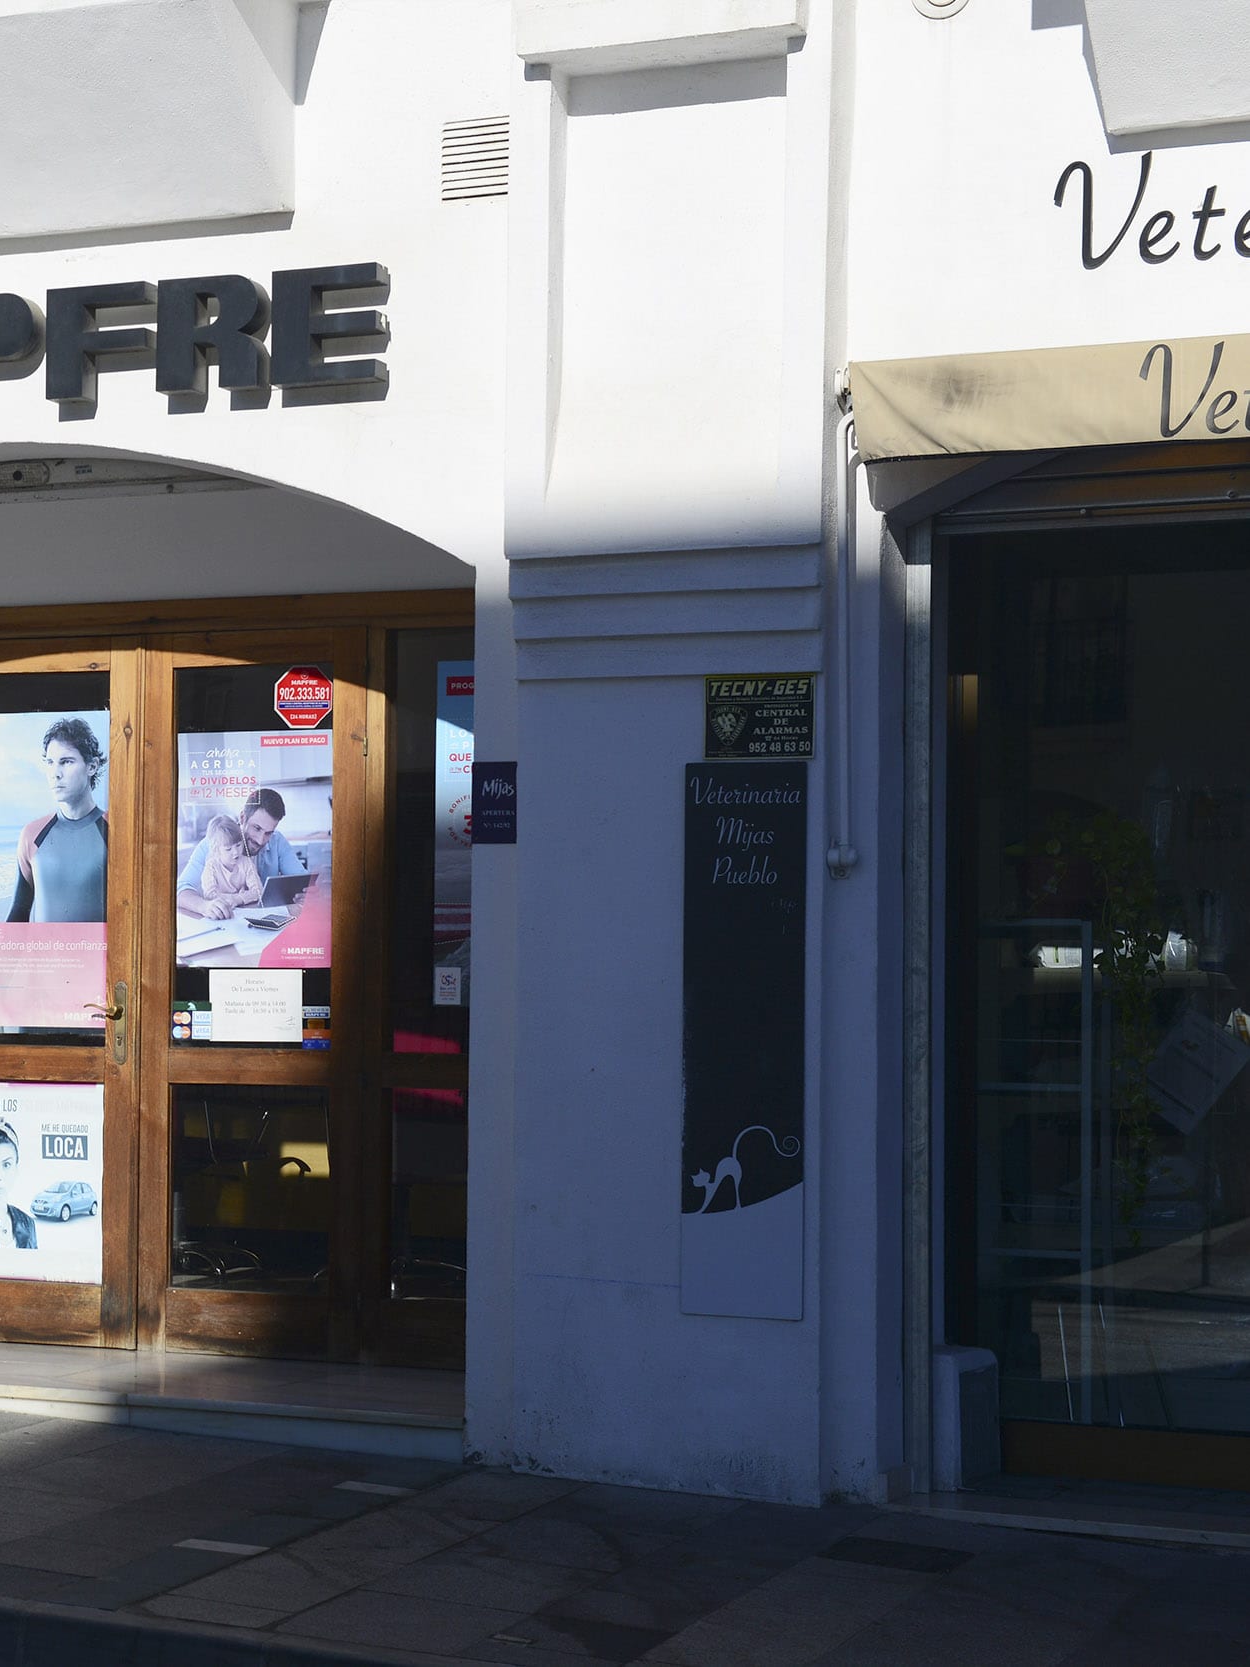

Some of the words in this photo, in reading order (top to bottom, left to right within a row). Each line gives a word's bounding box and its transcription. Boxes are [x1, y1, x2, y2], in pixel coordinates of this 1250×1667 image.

[1140, 341, 1250, 438] Ve
[279, 687, 330, 700] 902.333.581
[710, 679, 809, 697] TECNY-GES
[755, 709, 807, 717] CENTRAL
[753, 726, 808, 735] ALARMAS
[206, 747, 240, 758] ahora
[748, 742, 767, 753] 952
[769, 742, 781, 752] 48
[784, 741, 796, 752] 63
[799, 741, 811, 752] 50
[190, 759, 256, 769] AGRUPA
[190, 777, 197, 785] Y
[201, 788, 212, 798] 12
[216, 787, 256, 798] MESES
[481, 778, 515, 800] Mijas
[690, 776, 800, 804] Veterinaria
[716, 816, 775, 851] Mijas
[712, 856, 778, 885] Pueblo
[26, 940, 51, 953] global
[53, 940, 63, 950] de
[65, 940, 108, 951] confianza
[287, 947, 325, 955] MAPFRE
[2, 1099, 18, 1112] LOS
[41, 1123, 50, 1132] ME
[52, 1124, 60, 1132] HE
[45, 1136, 84, 1158] LOCA
